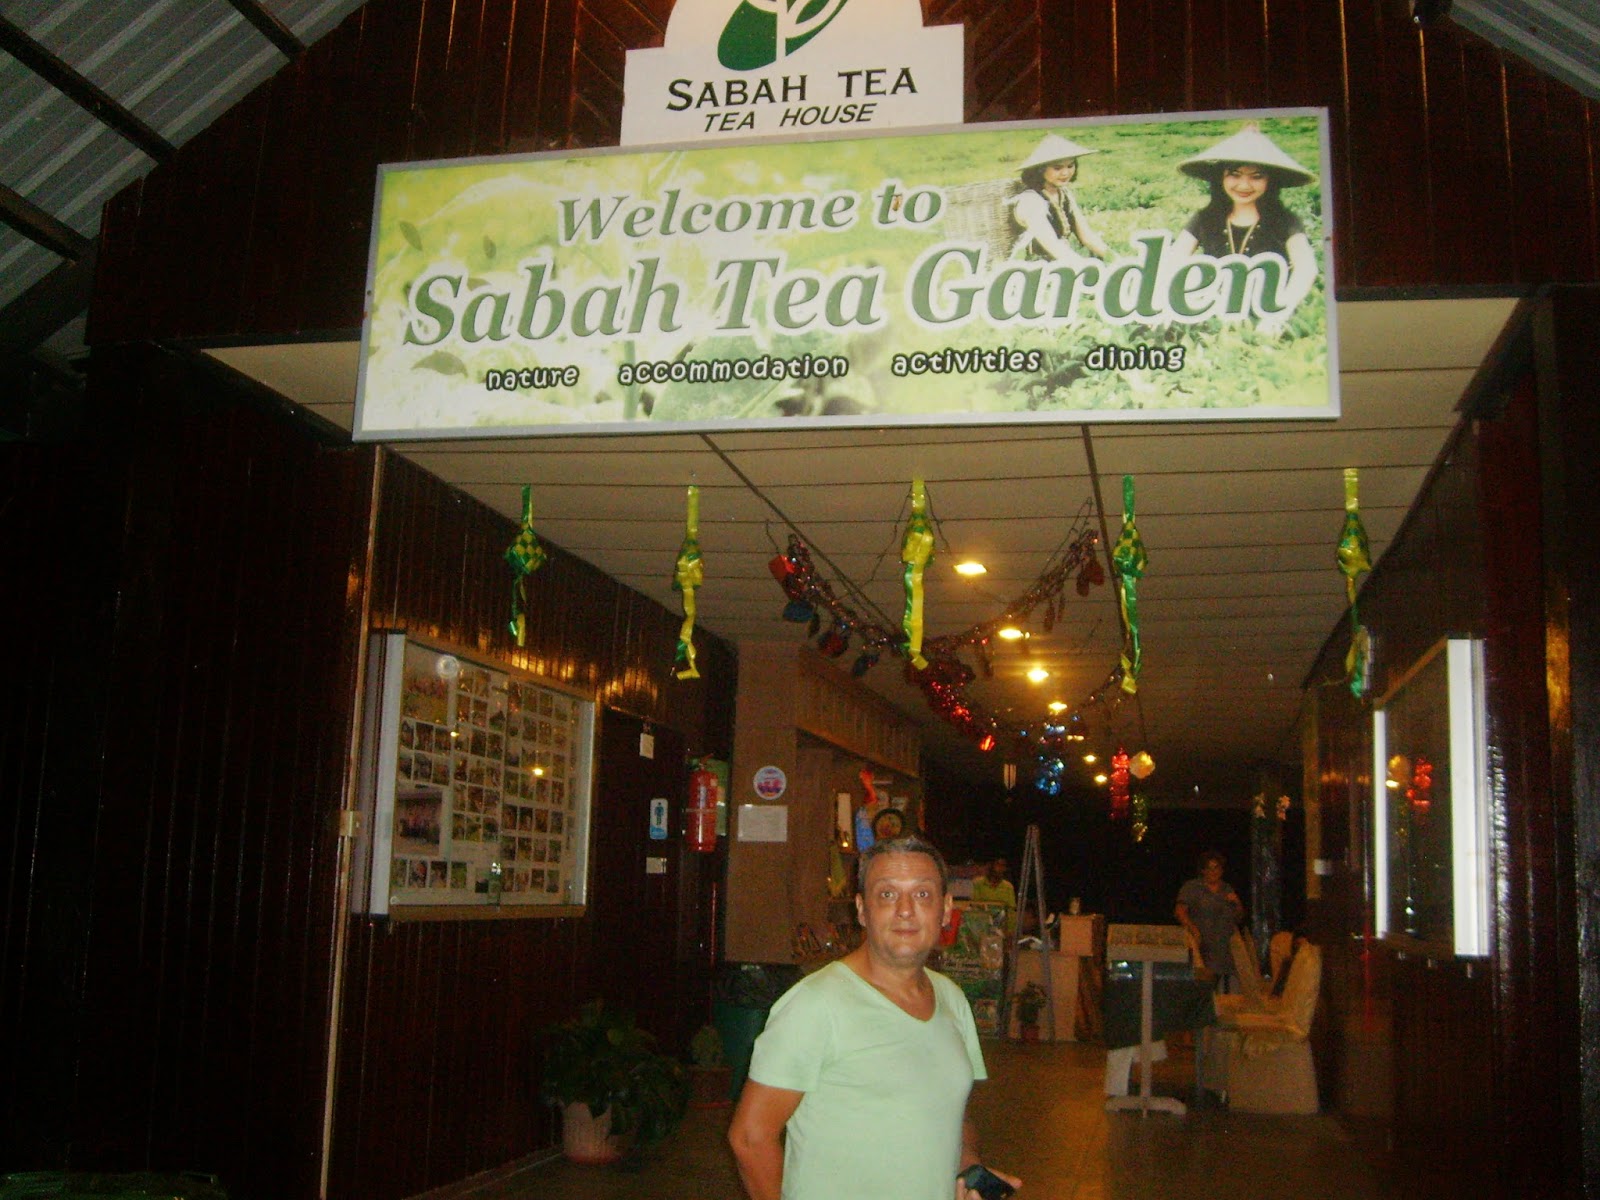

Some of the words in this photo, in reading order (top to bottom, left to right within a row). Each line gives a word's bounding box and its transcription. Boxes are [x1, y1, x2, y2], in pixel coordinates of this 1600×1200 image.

[666, 74, 807, 111] SABAH
[838, 67, 918, 98] TEA
[703, 112, 757, 133] TEA
[779, 103, 877, 128] HOUSE
[560, 188, 855, 241] Welcome
[876, 180, 942, 226] to
[402, 256, 682, 346] Sabah
[714, 257, 880, 331] Tea
[911, 235, 1285, 323] Garden
[486, 364, 580, 391] nature
[617, 353, 850, 386] accommodation
[892, 346, 1042, 377] activities
[1084, 343, 1186, 372] dining
